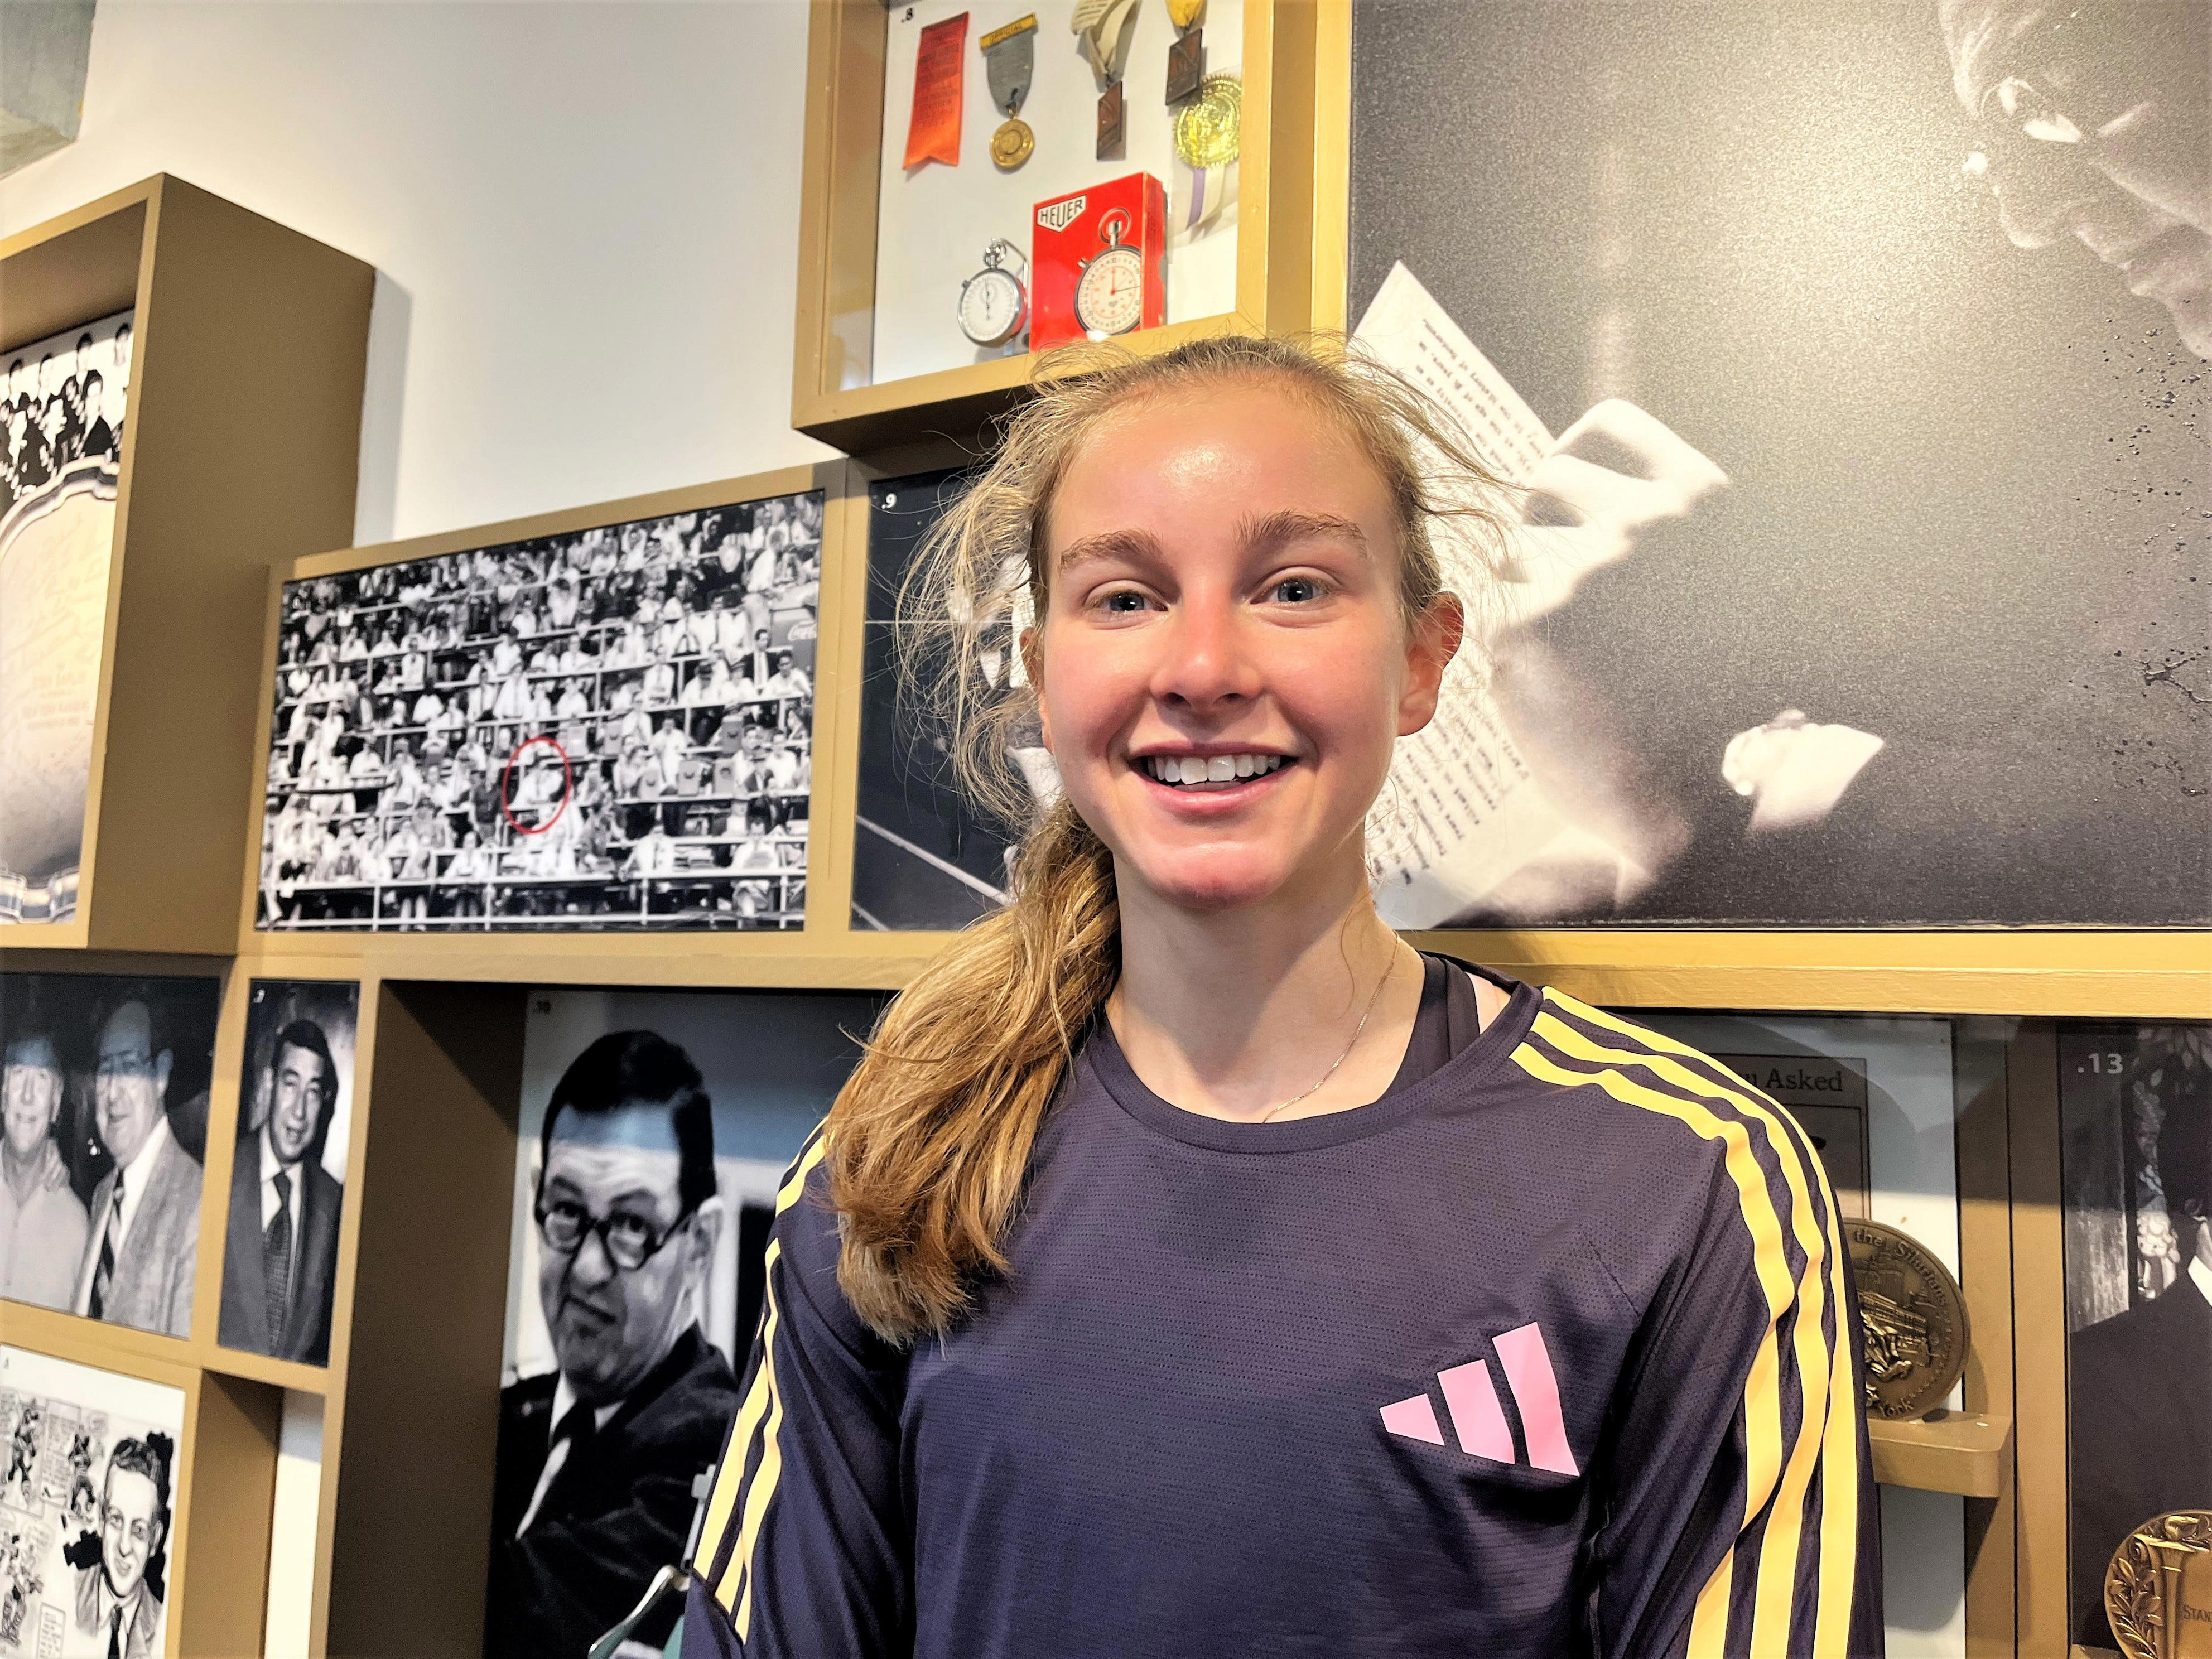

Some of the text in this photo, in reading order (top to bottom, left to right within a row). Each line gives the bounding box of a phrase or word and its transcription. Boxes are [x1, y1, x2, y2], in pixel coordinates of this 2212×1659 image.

[1040, 200, 1082, 227] HEUER
[881, 493, 897, 509] .9
[2078, 1053, 2123, 1074] .13
[1765, 1068, 1843, 1092] Asked
[1854, 1229, 1883, 1248] the
